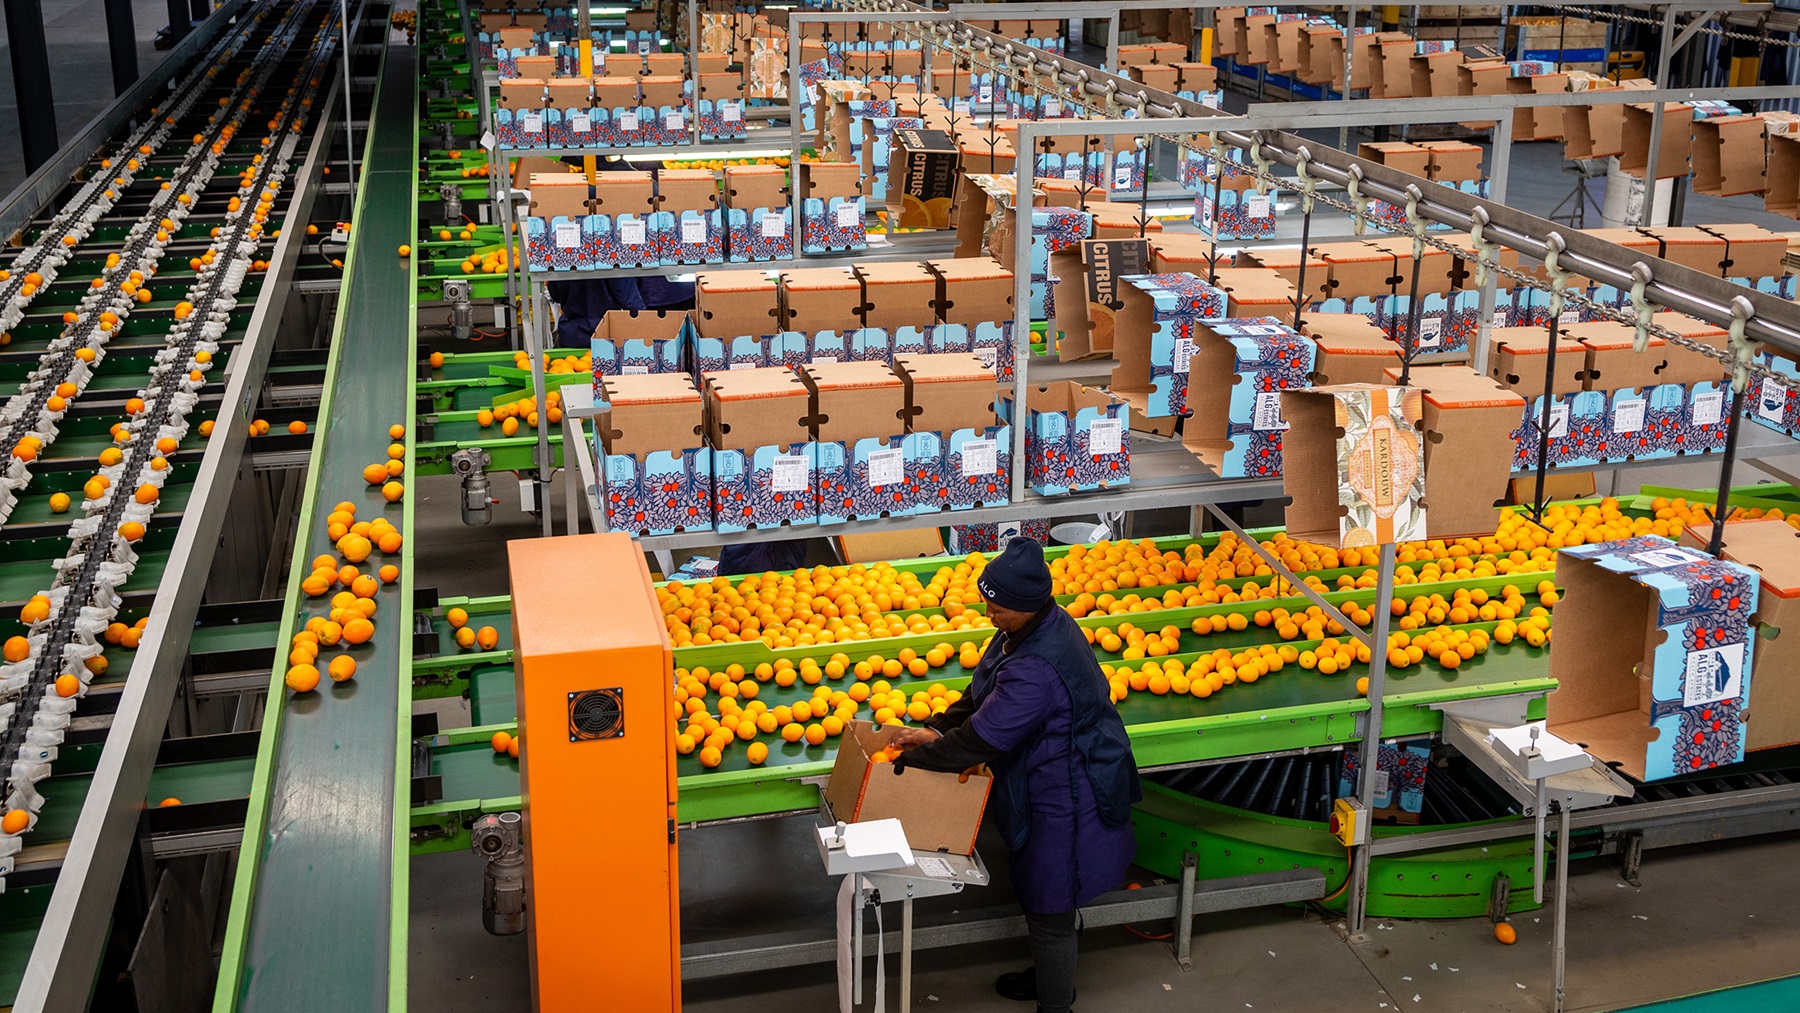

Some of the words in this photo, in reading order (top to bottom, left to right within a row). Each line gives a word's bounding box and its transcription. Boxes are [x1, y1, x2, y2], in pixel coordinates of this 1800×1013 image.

[910, 153, 927, 196] CITRUS
[1092, 242, 1113, 305] CITRUS
[1182, 340, 1191, 353] ALG
[1264, 395, 1274, 409] ALG
[1379, 438, 1390, 498] KARDOUW
[979, 580, 996, 598] ALG
[1697, 654, 1708, 674] ALG
[1695, 674, 1703, 701] ESTATES
